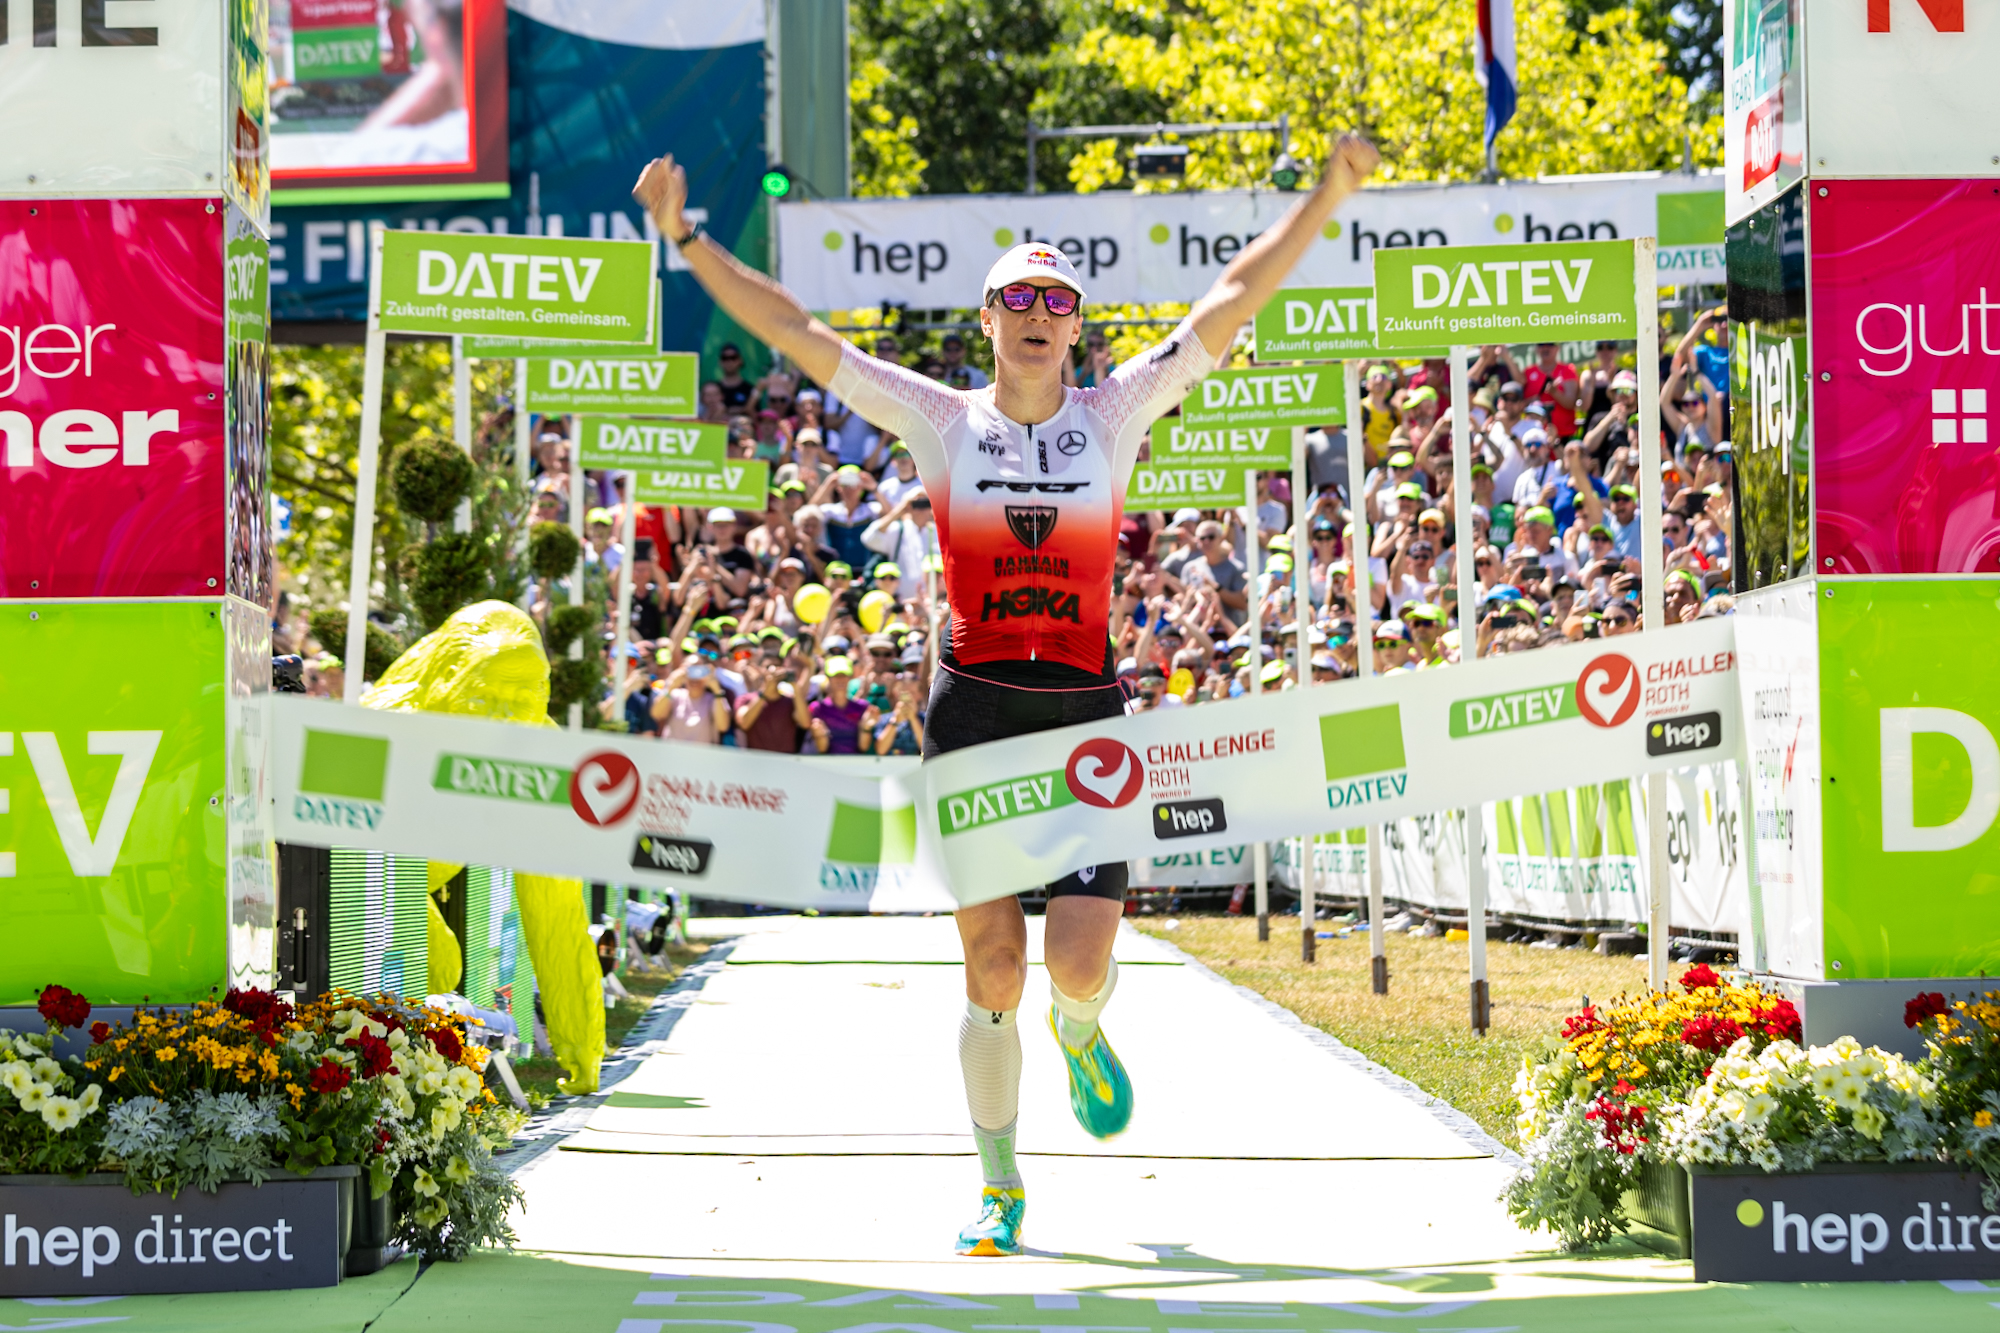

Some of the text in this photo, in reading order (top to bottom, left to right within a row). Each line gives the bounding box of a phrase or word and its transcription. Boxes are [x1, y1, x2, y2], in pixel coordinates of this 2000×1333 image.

[296, 40, 374, 66] DATEV
[853, 232, 947, 282] hep
[1179, 225, 1265, 266] he
[1656, 248, 1726, 271] DATEV
[417, 250, 603, 303] DATEV
[1412, 258, 1593, 309] DATEV
[385, 300, 631, 328] Zukunft gestalten. Gemeinsam.
[1383, 310, 1627, 332] Zukunft gestalten. Gemeinsam.
[1856, 287, 2000, 377] gut
[1264, 338, 1371, 353] Zukunft gestalten.
[548, 358, 669, 391] DATEV
[1202, 373, 1319, 409] DATEV
[1750, 321, 1797, 475] hep
[1186, 411, 1225, 424] Zukunft
[598, 423, 702, 455] DATEV
[976, 480, 1091, 493] FELT
[1137, 469, 1227, 494] DATEV
[994, 555, 1069, 569] BAHRAIN
[994, 567, 1069, 579] VICTORIOUS
[980, 586, 1082, 624] HOKA
[1465, 686, 1565, 734] DATEV
[1645, 681, 1690, 708] ROTH
[1146, 728, 1276, 766] CHALLENGE
[1664, 722, 1711, 748] hep
[449, 755, 563, 801] DATEV
[1149, 767, 1191, 789] ROTH
[1150, 788, 1192, 800] POWERED BY
[1327, 773, 1408, 811] DATEV
[0, 730, 164, 878] V
[293, 794, 384, 832] DATEV
[948, 776, 1053, 831] DATEV
[1171, 806, 1214, 832] hep
[650, 837, 700, 875] hep
[4, 1214, 293, 1277] hep direct
[1772, 1200, 1890, 1265] hep
